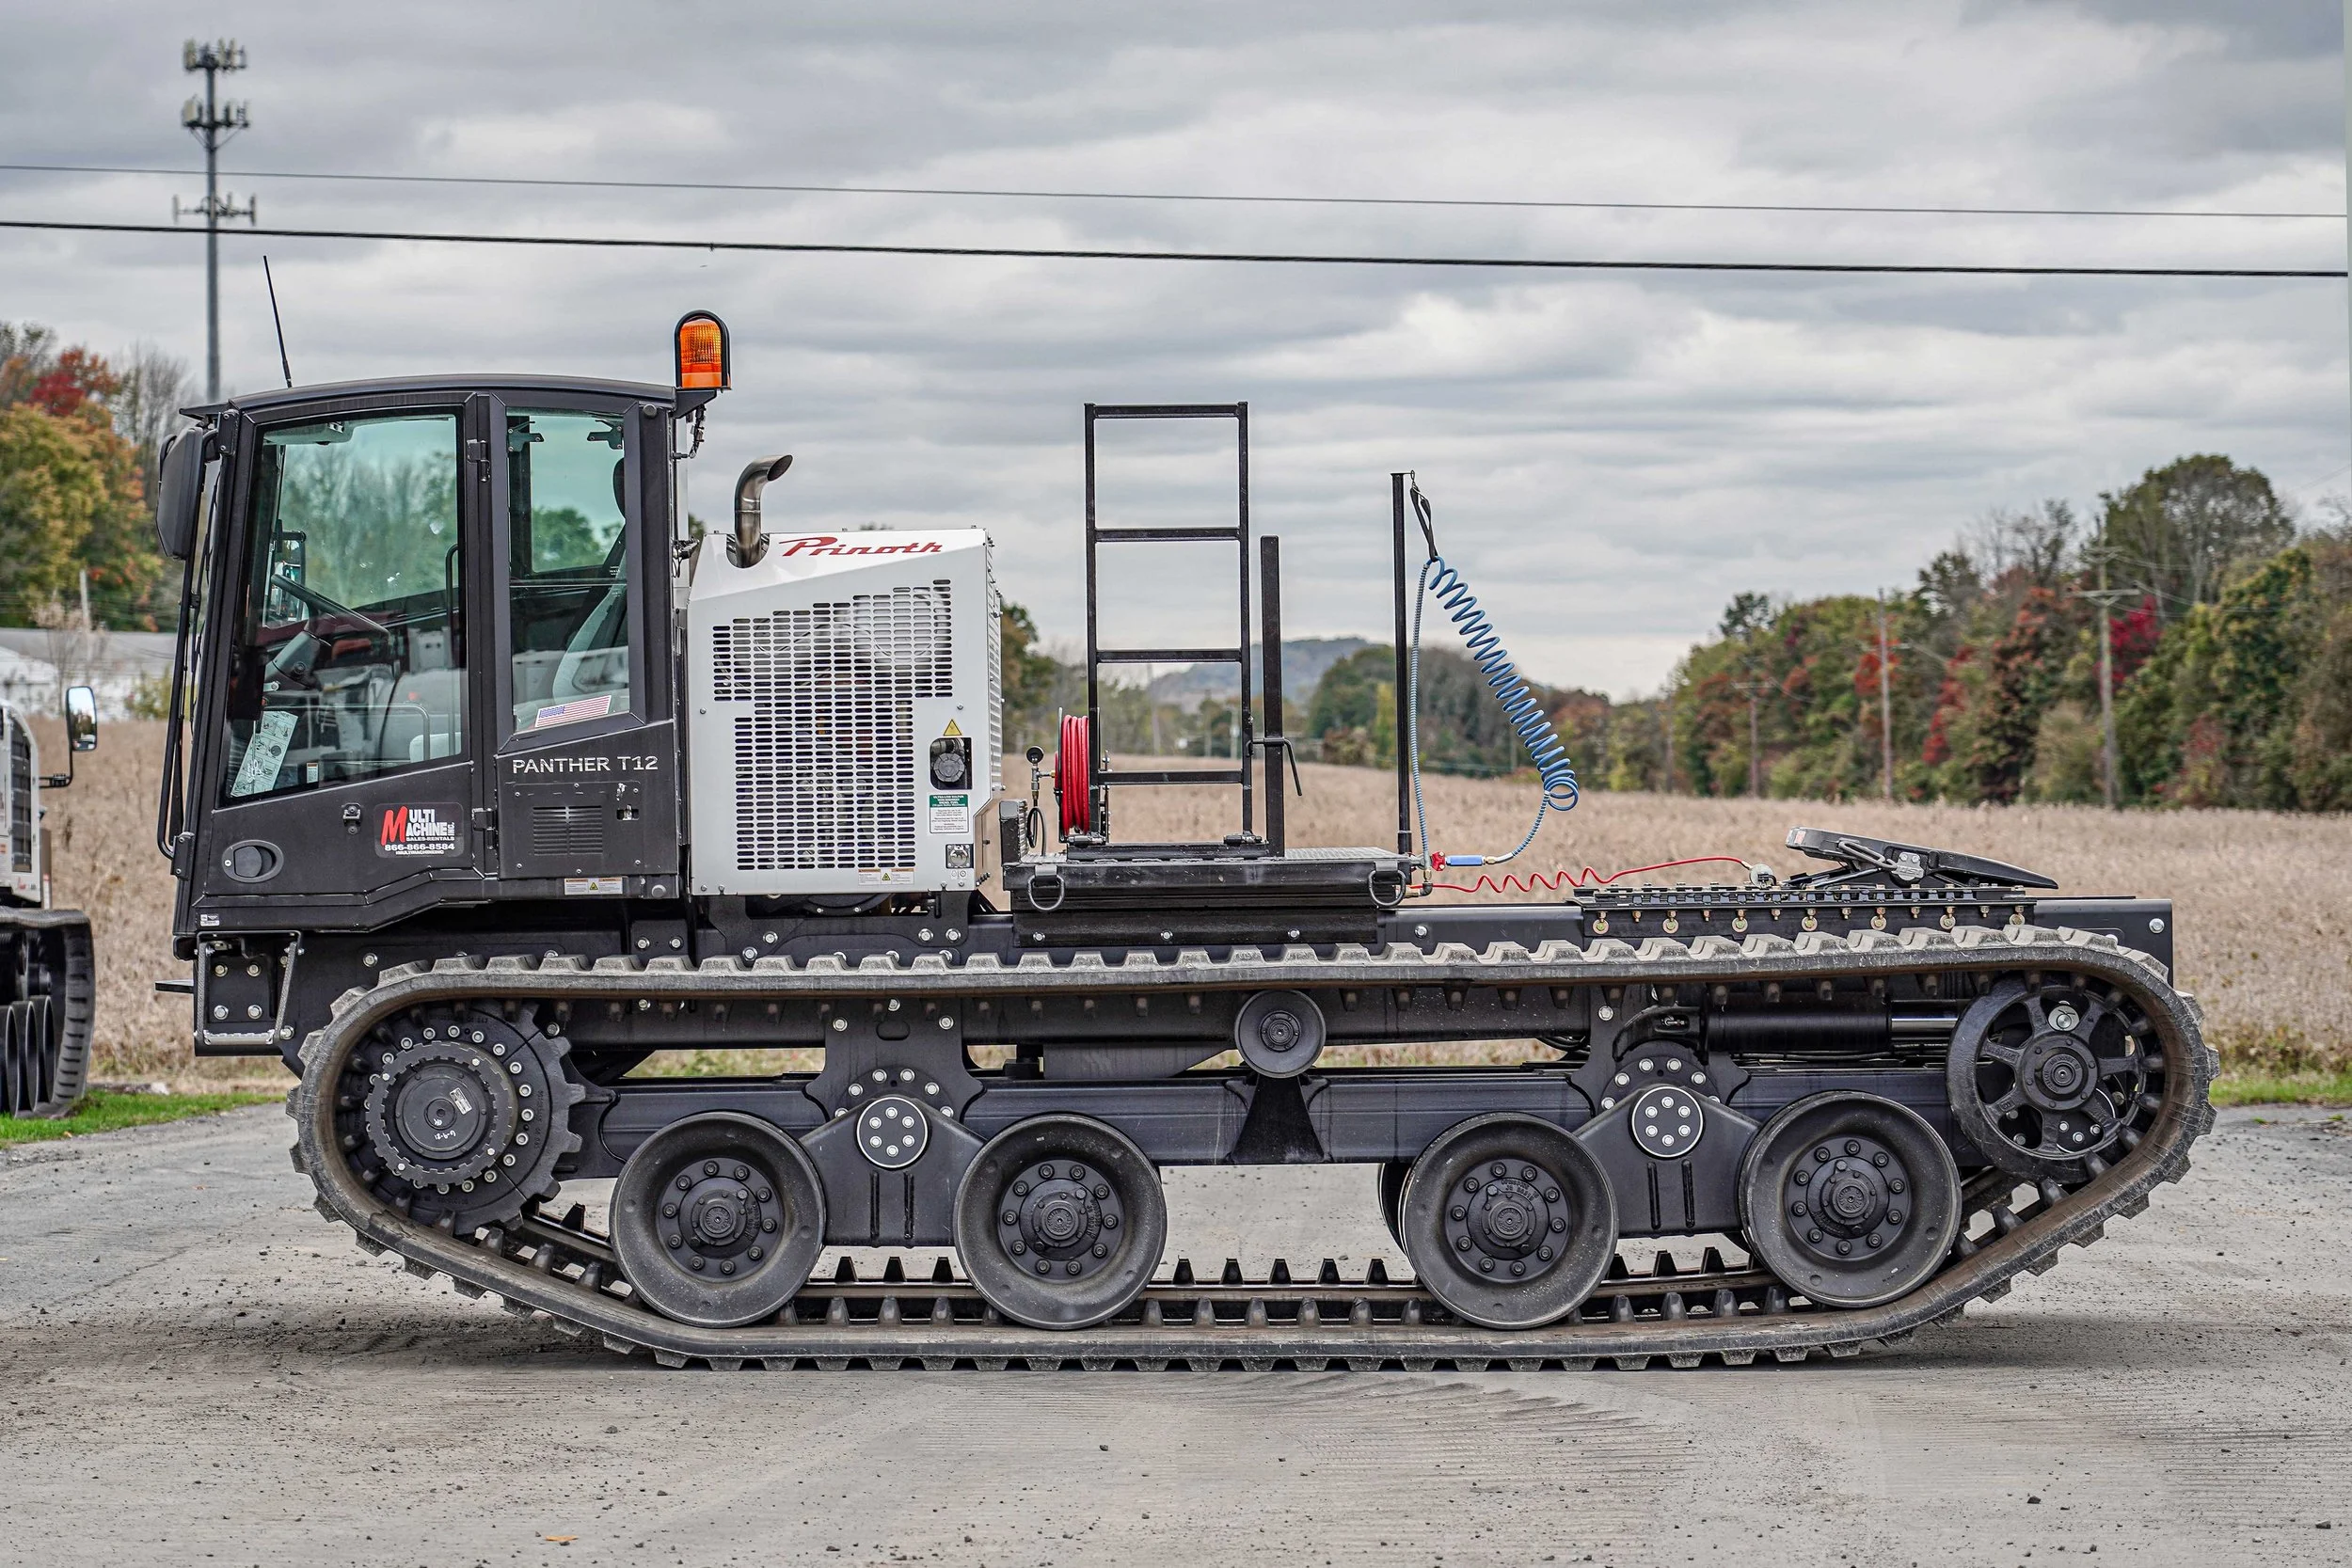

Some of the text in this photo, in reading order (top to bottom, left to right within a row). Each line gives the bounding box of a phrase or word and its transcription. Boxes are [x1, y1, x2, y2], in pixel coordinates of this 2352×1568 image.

[778, 536, 943, 557] Prinoth
[512, 755, 659, 774] PANTHER T12
[384, 843, 455, 851] 866-866-8584
